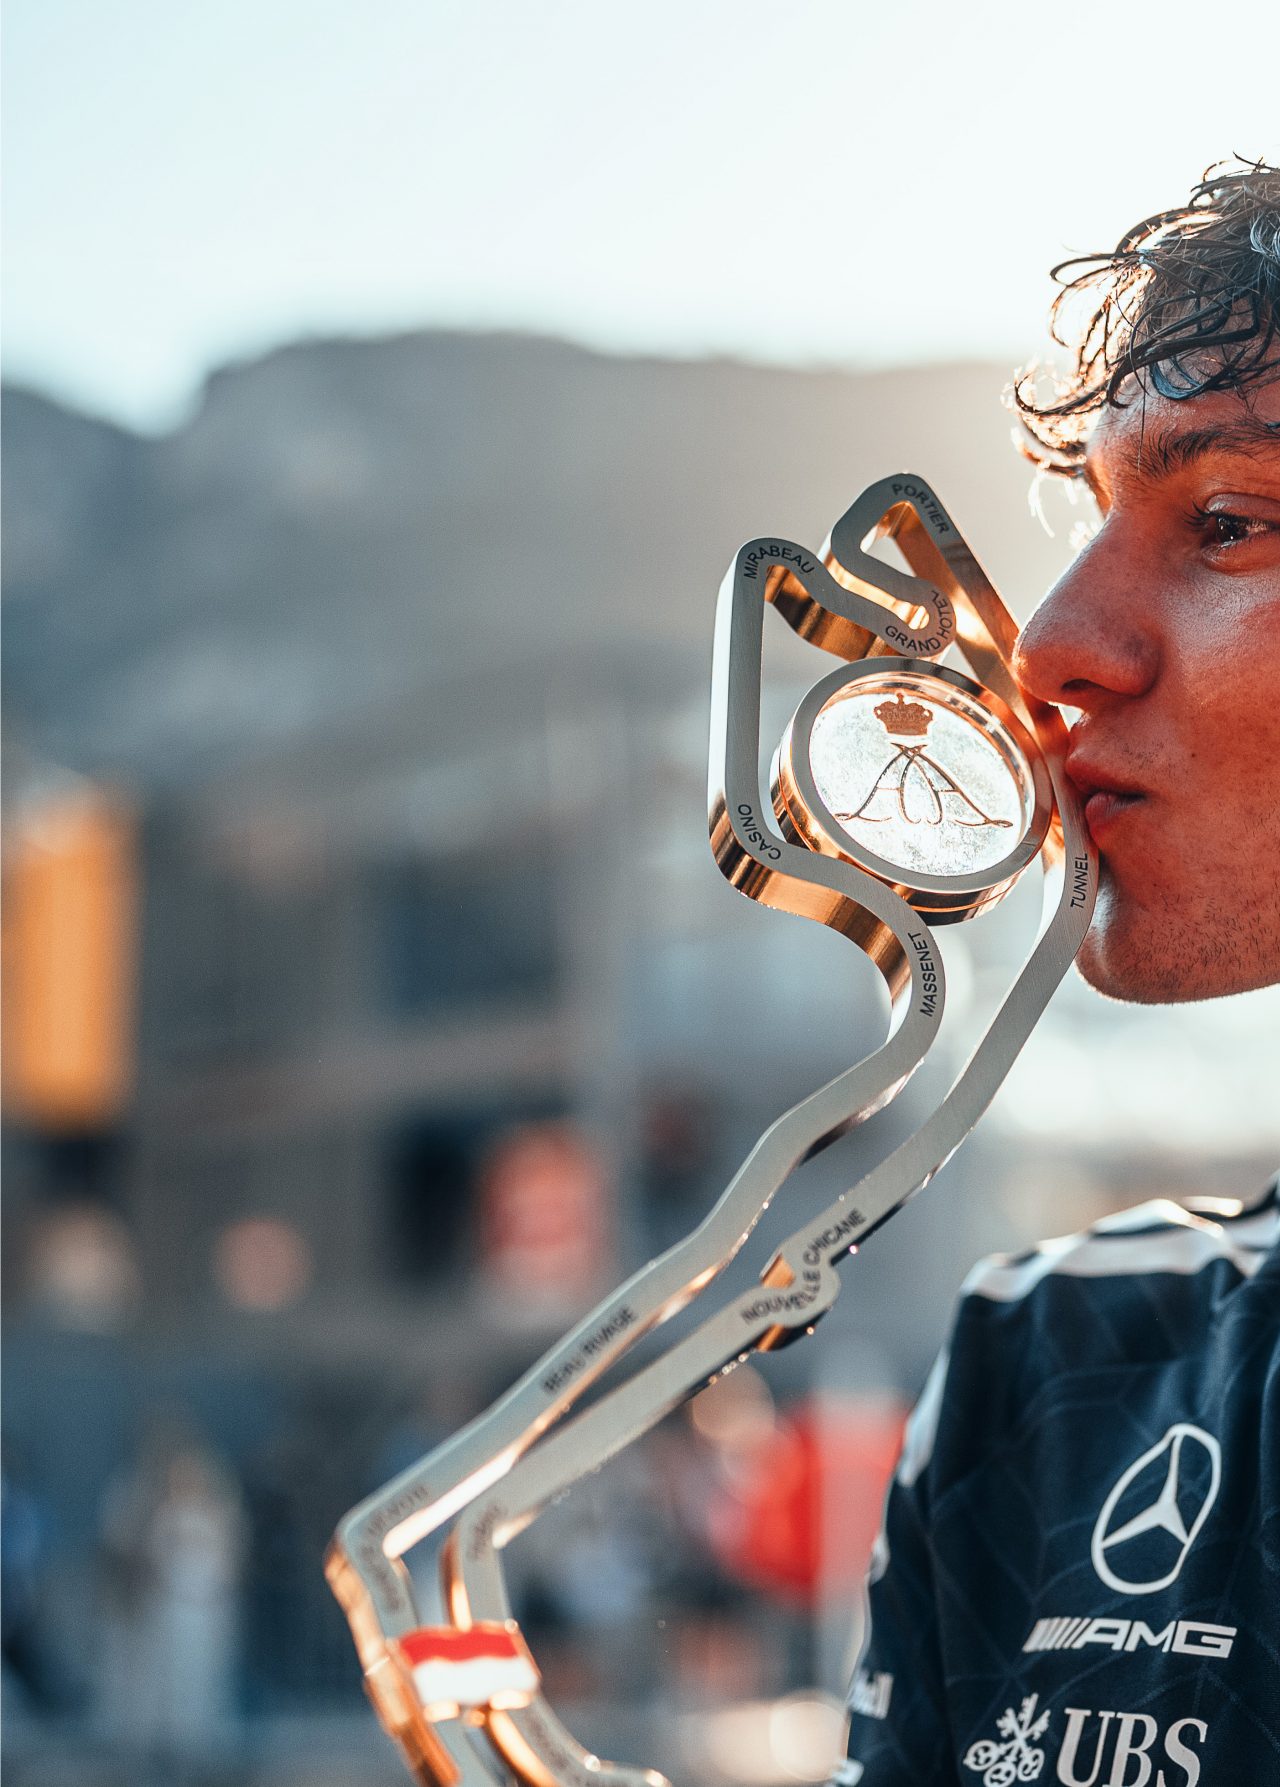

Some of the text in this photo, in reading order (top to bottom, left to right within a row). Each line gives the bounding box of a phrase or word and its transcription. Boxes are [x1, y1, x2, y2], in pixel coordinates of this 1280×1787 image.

[892, 482, 949, 535] PORTIER
[744, 545, 815, 580] MIRABEAU
[885, 590, 953, 652] GRAND HOTEL
[738, 803, 782, 861] CASINO
[1070, 853, 1088, 909] TUNNEL
[908, 931, 938, 1018] MASSENET
[741, 1208, 867, 1325] NOUVELLE CHICANE
[1072, 1616, 1238, 1659] AMG
[1056, 1707, 1208, 1787] UBS
